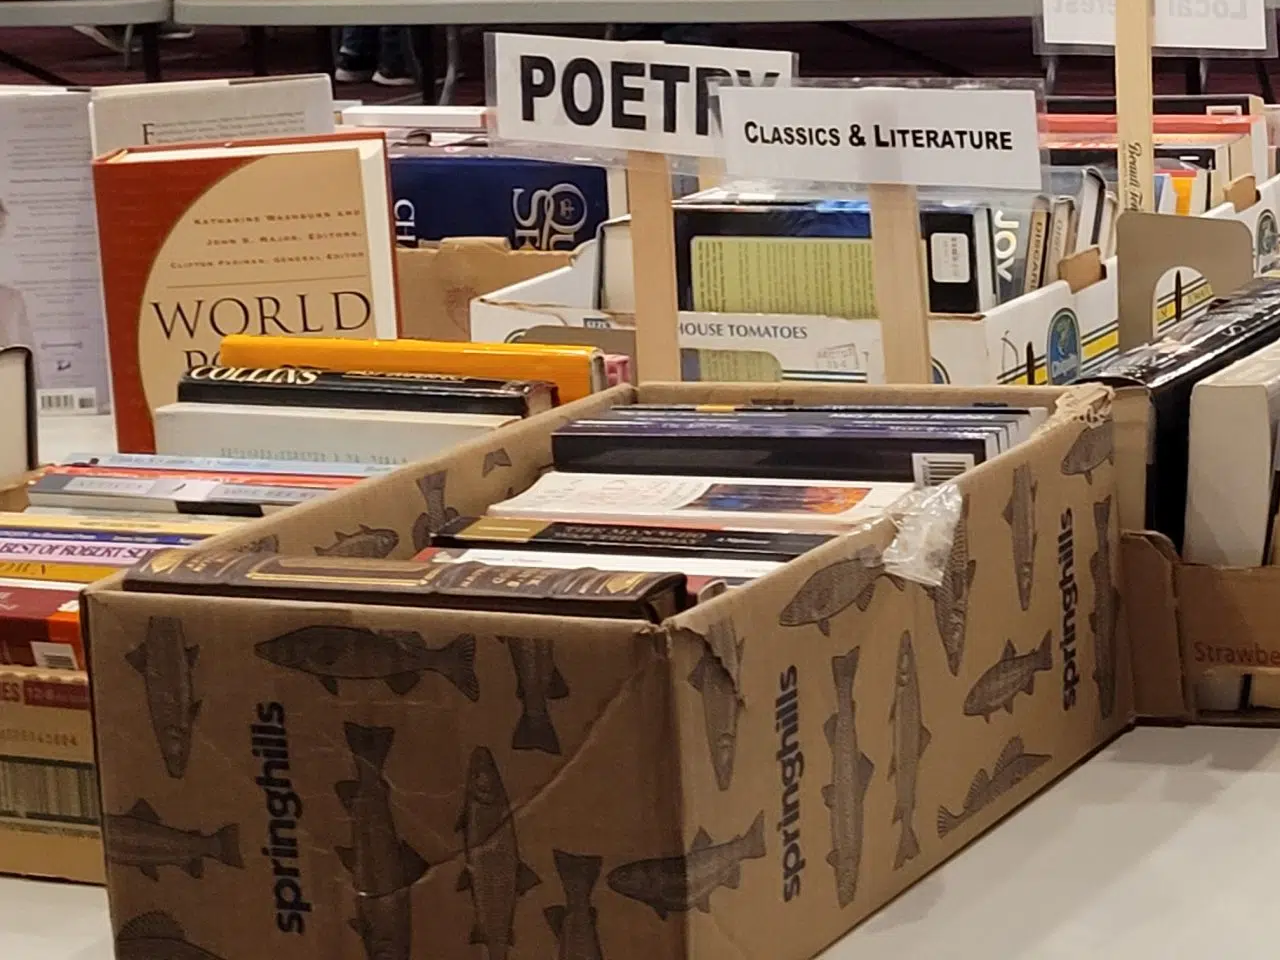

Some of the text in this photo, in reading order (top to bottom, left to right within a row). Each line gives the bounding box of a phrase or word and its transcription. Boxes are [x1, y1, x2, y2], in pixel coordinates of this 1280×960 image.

[520, 54, 780, 138] POETR
[744, 121, 1013, 151] CLASSICS & LITERATURE
[151, 291, 372, 341] WORLD
[729, 324, 808, 340] TOMATOES
[191, 366, 323, 386] COLLINS
[1057, 508, 1080, 713] springhills
[775, 664, 806, 903] springhills
[250, 701, 311, 935] springhills
